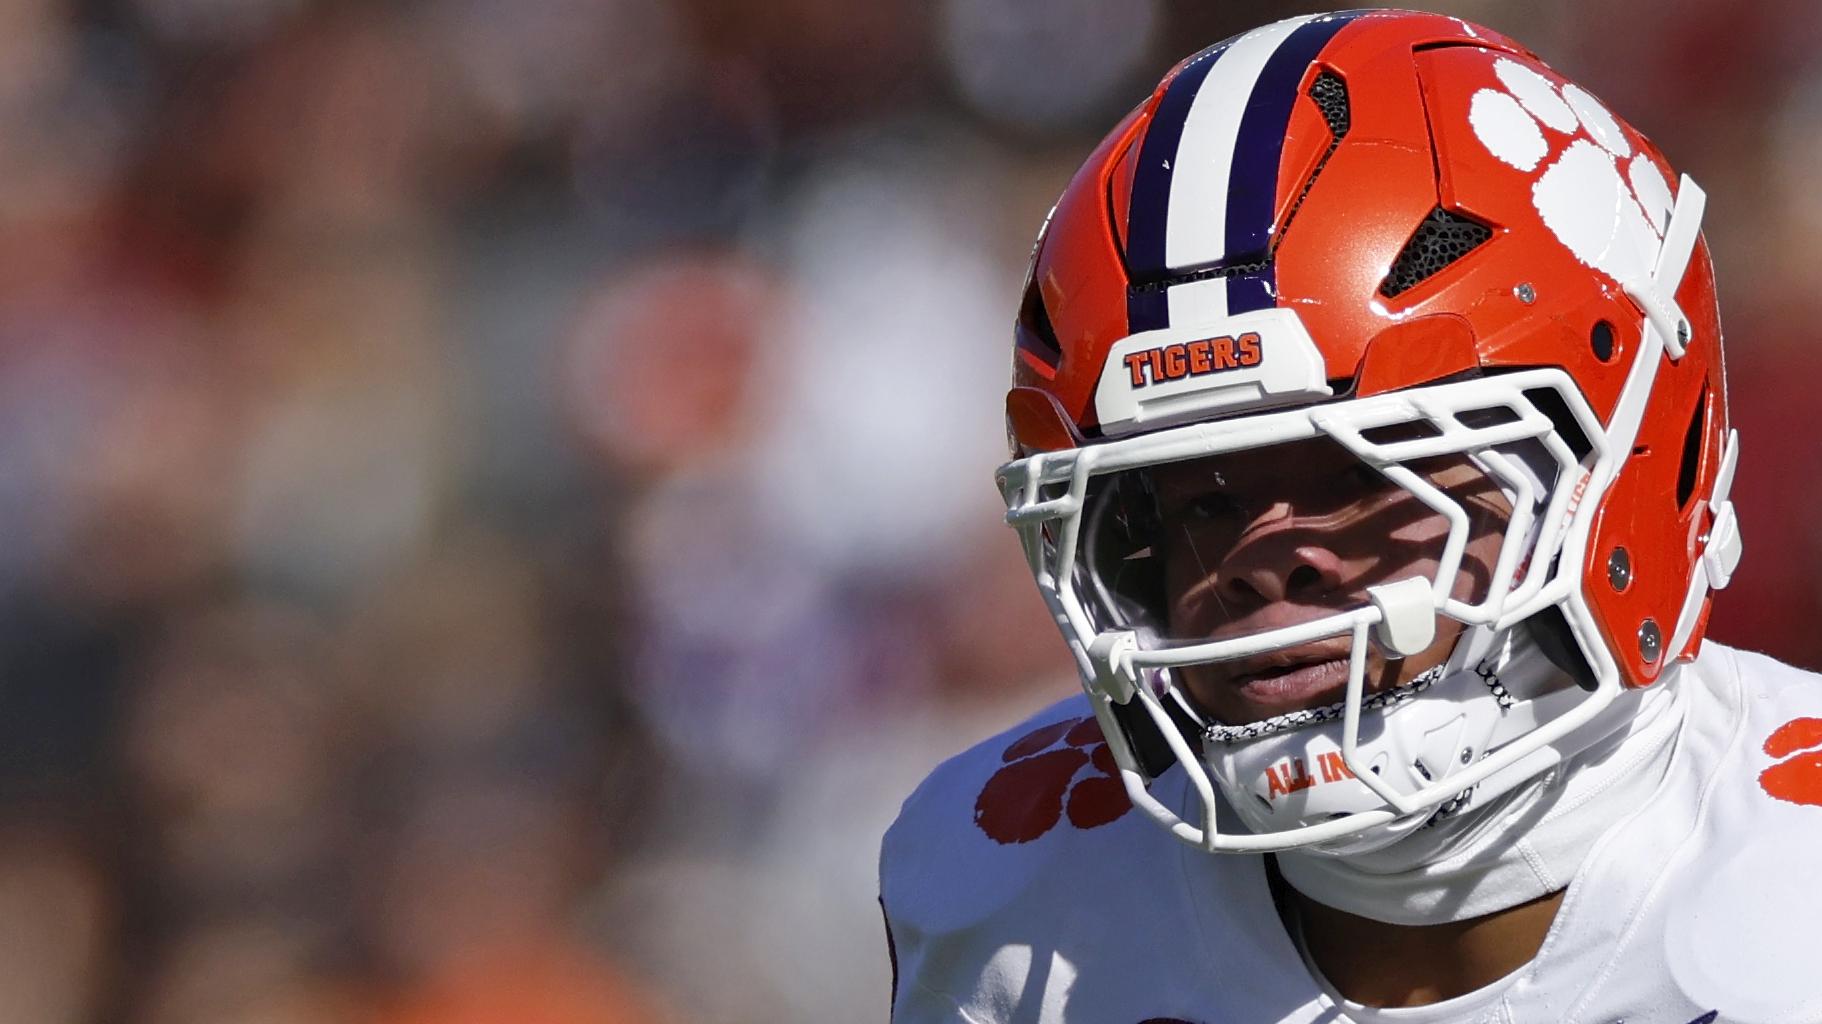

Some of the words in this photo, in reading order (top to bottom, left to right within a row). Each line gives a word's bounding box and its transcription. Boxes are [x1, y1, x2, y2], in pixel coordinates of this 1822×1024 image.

[1123, 332, 1264, 390] TIGERS
[1265, 759, 1317, 800] ALL
[1316, 752, 1357, 784] IN
